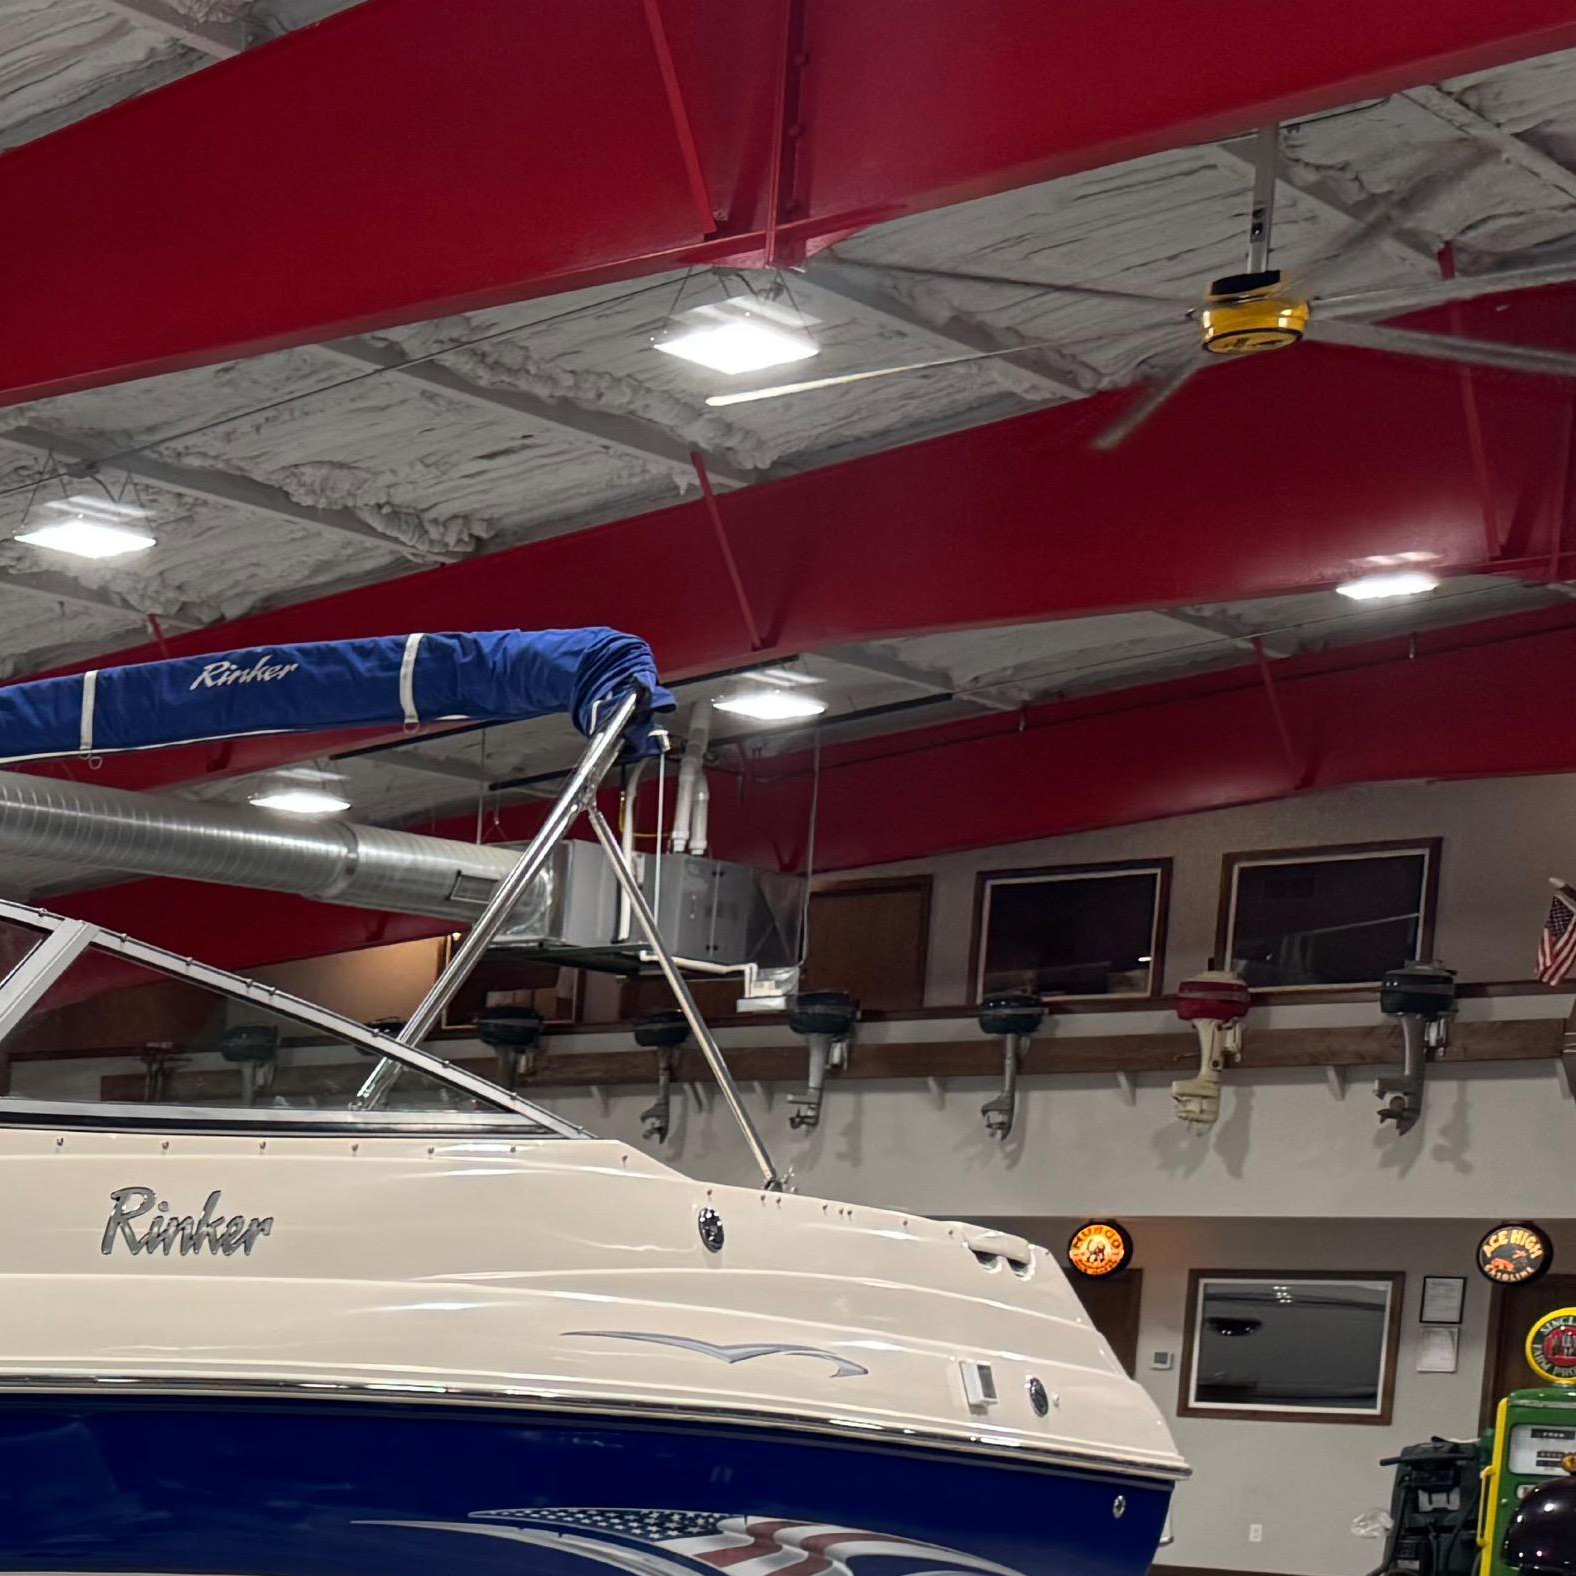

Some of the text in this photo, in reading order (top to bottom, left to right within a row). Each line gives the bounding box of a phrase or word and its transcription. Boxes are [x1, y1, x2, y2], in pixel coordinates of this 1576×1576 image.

[189, 654, 300, 691] Rinker
[100, 1186, 275, 1257] Rinker
[1482, 1229, 1544, 1260] ACE HIGH
